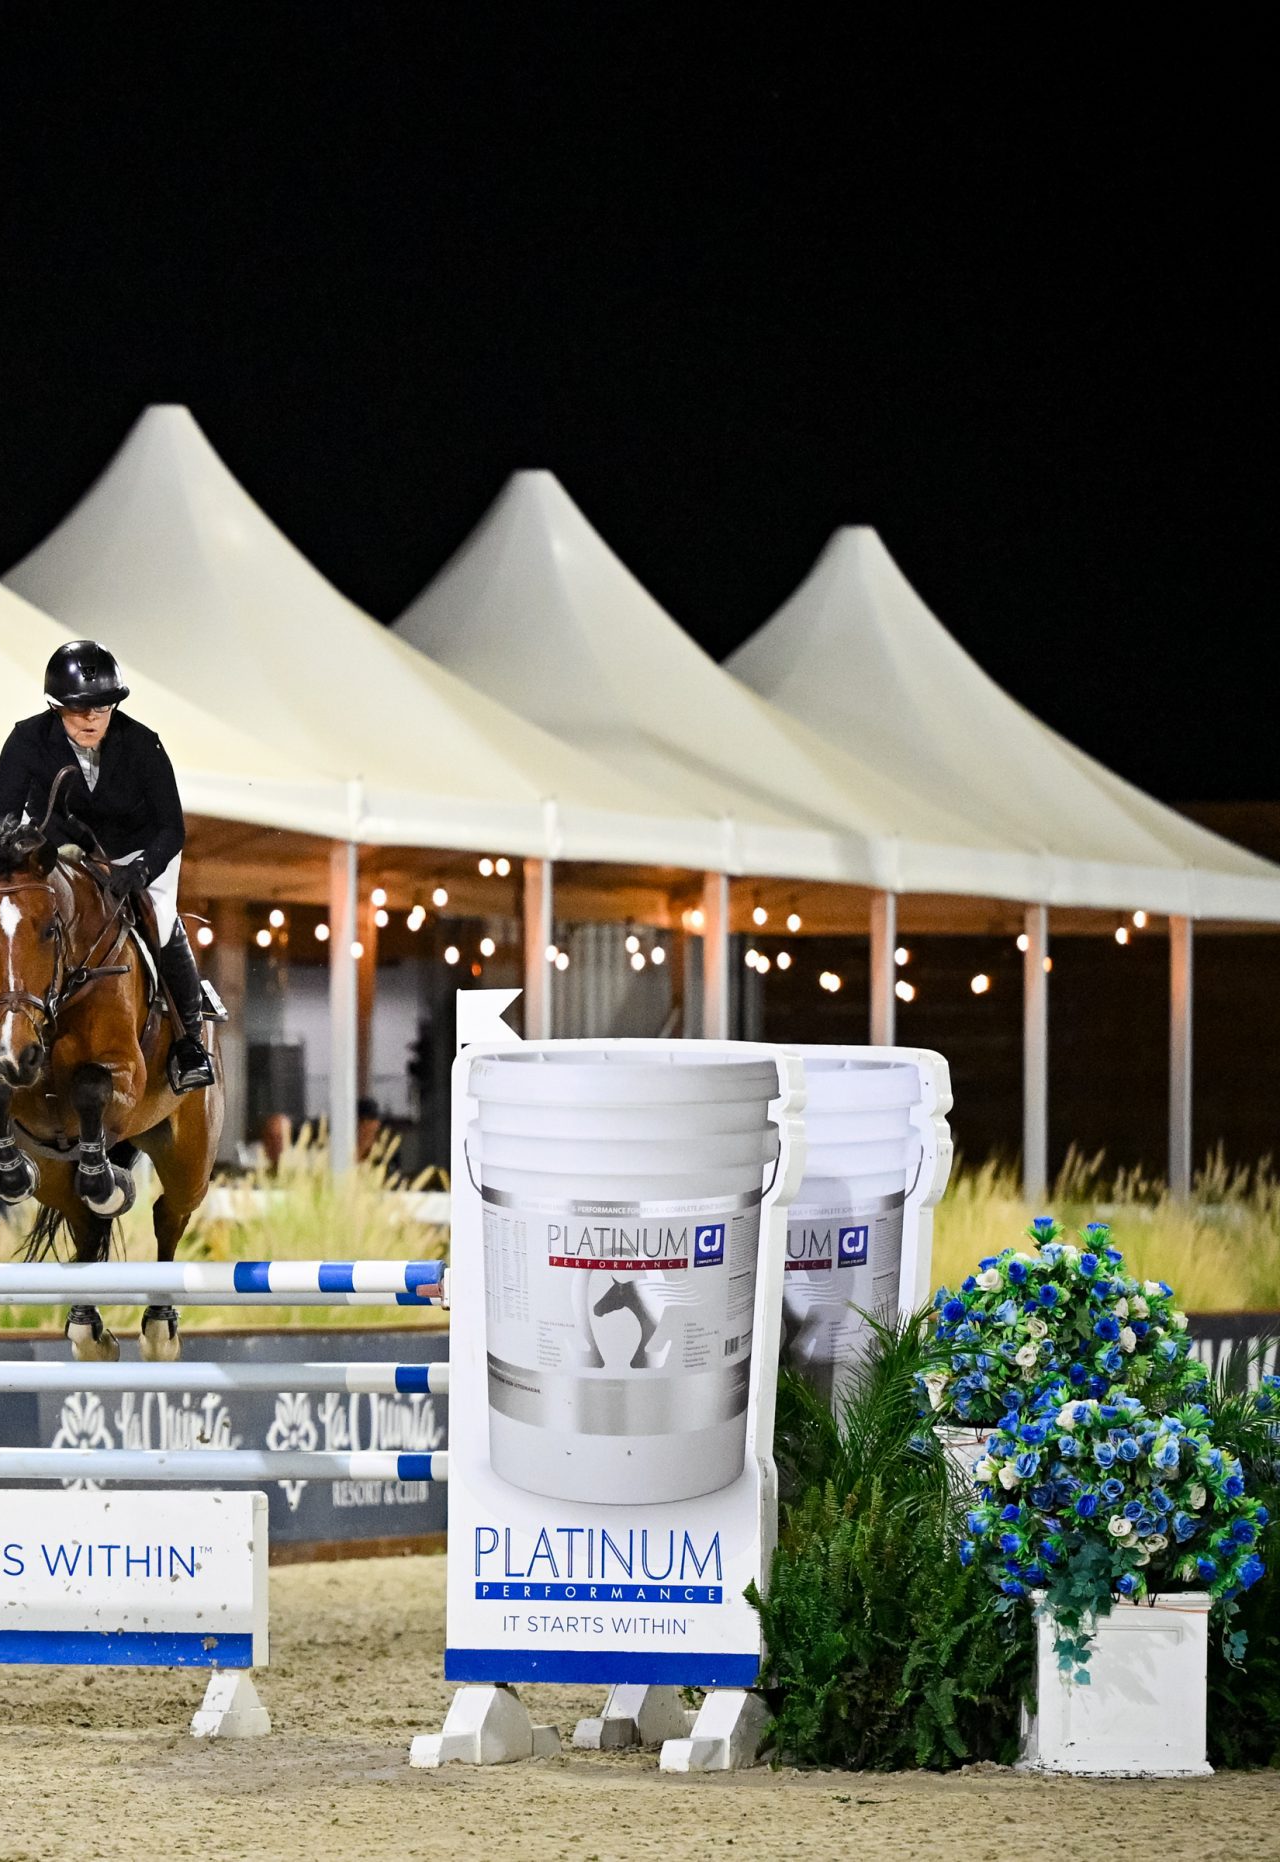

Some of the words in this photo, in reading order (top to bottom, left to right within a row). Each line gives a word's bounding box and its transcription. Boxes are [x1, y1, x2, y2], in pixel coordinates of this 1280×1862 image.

[547, 1224, 688, 1257] PLATINUM
[698, 1228, 721, 1252] CJ
[842, 1230, 865, 1254] CJ
[553, 1258, 684, 1269] PERFORMANCE
[475, 1526, 723, 1580] PLATINUM
[482, 1585, 715, 1601] PERFORMANCE
[503, 1615, 520, 1632] IT
[527, 1616, 604, 1634] STARTS
